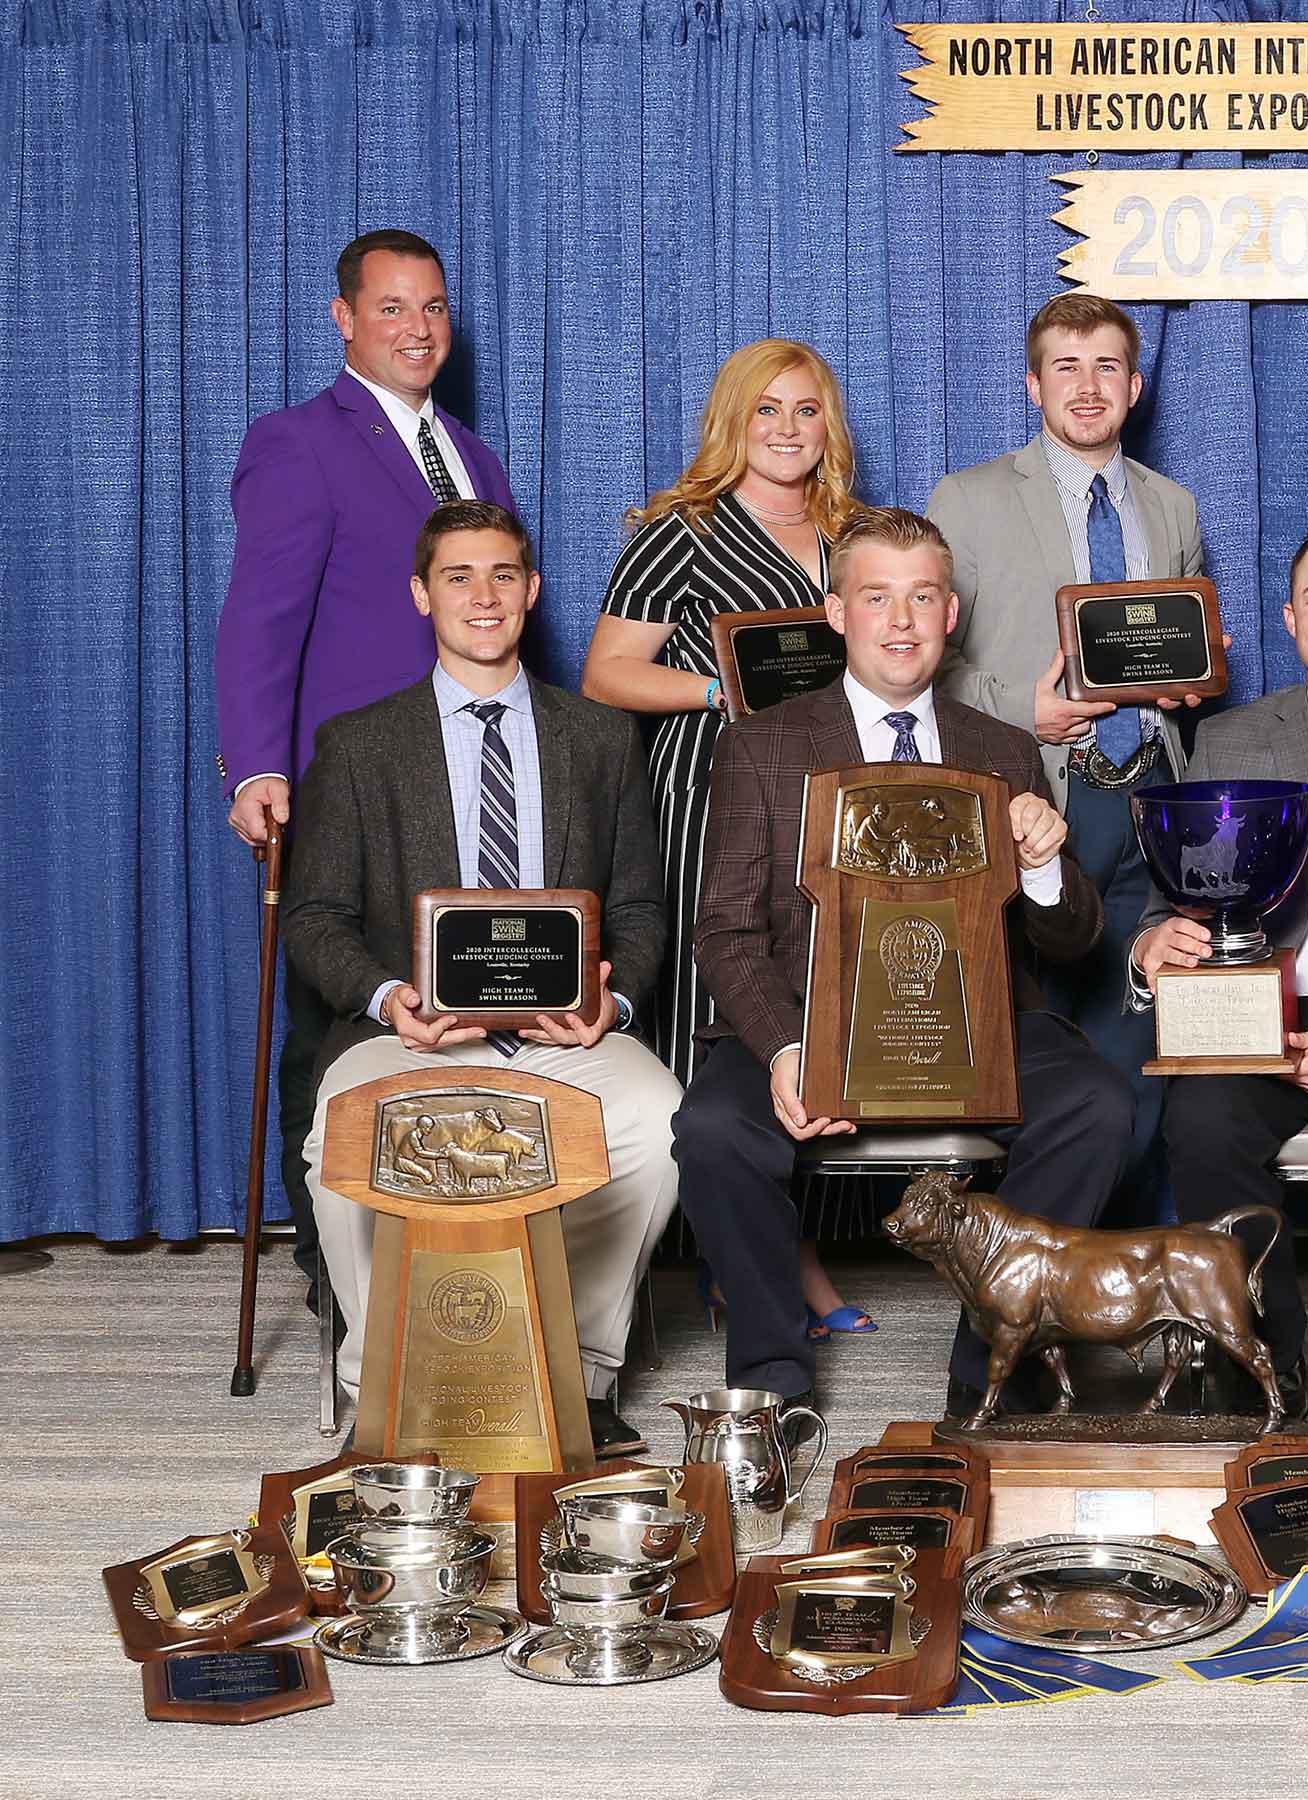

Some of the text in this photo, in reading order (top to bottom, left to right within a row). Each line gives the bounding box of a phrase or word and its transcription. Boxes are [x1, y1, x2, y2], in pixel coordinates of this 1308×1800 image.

[948, 38, 1054, 77] NORTH
[1070, 37, 1237, 77] AMERICAN
[1035, 93, 1209, 132] LIVESTOCK
[493, 925, 526, 934] SWINE
